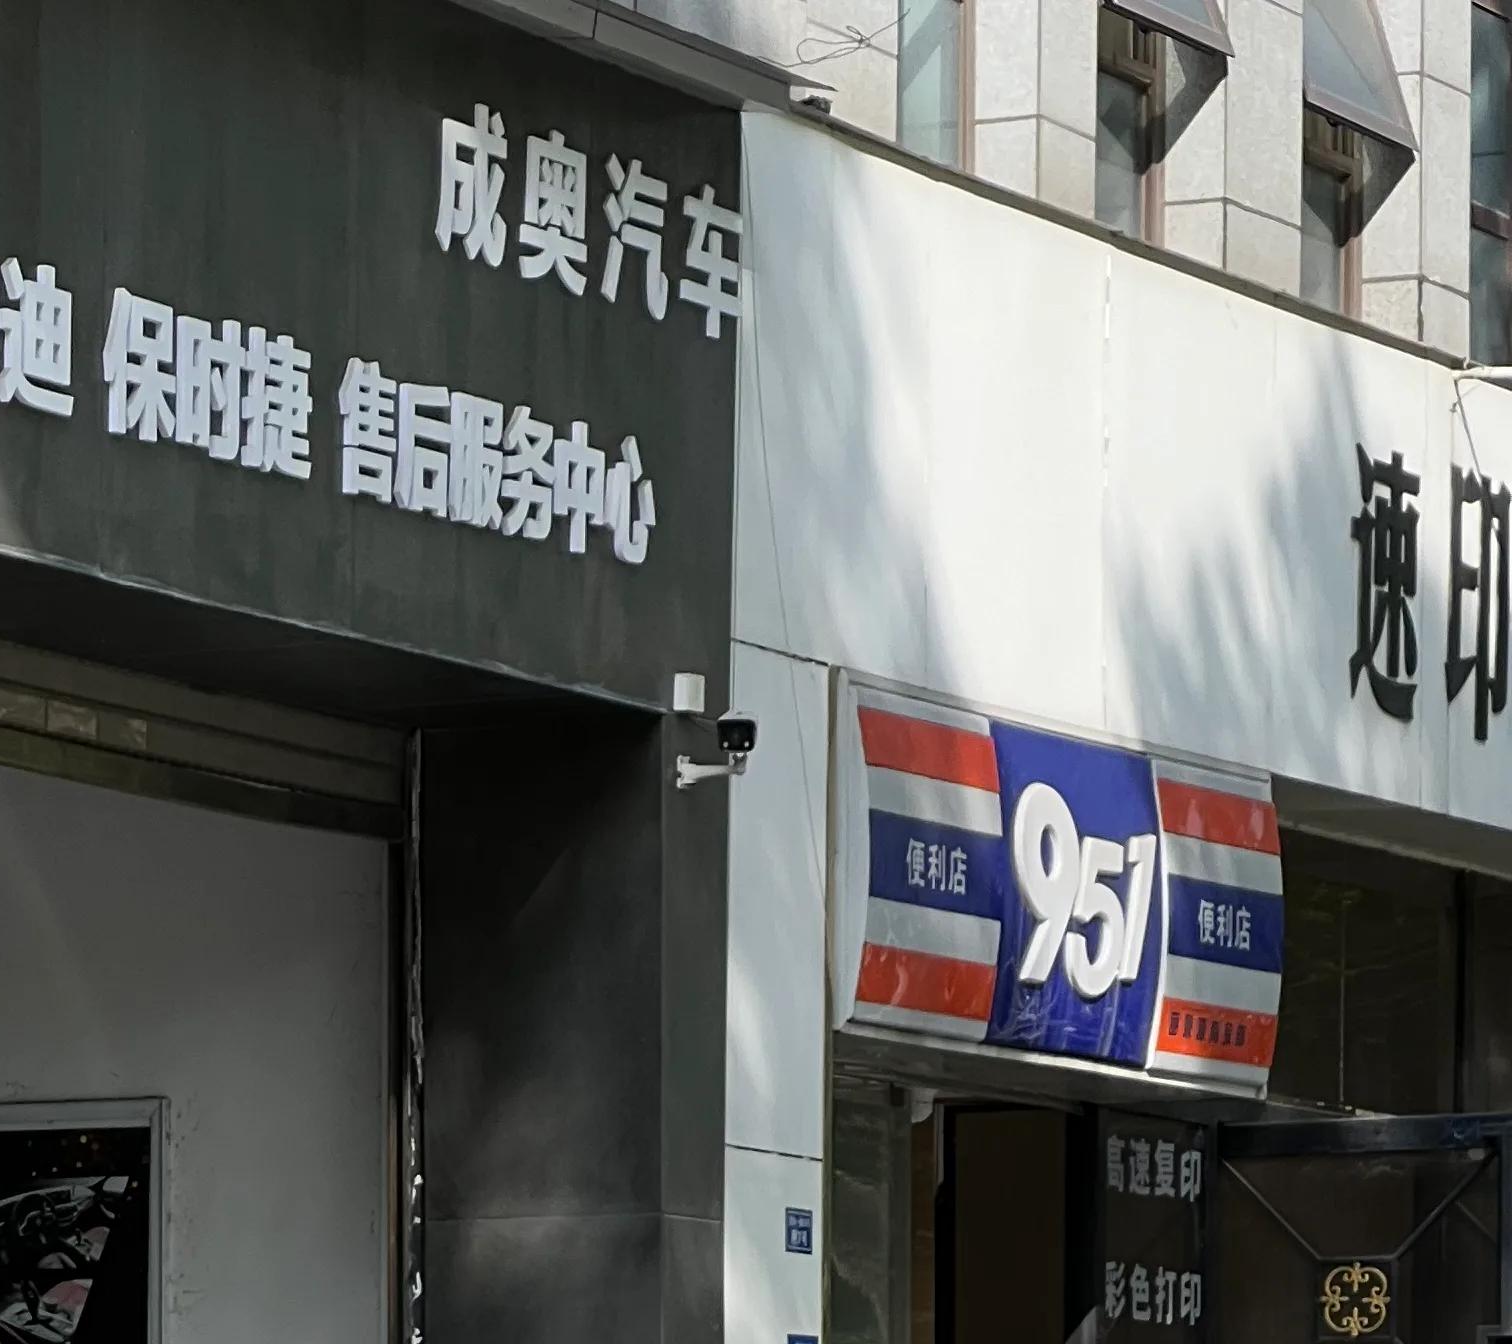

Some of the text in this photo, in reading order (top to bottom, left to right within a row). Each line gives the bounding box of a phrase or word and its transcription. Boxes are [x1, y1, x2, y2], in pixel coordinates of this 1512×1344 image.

[435, 103, 744, 339] 成奥汽车
[103, 287, 313, 480] 保时捷
[338, 356, 656, 564] 售后服务中心
[905, 836, 969, 896] 便利店
[1013, 782, 1157, 998] 951
[1197, 897, 1251, 951] 便利店
[1105, 1134, 1202, 1202] 高速复印
[1104, 1260, 1202, 1327] 彩色打印
